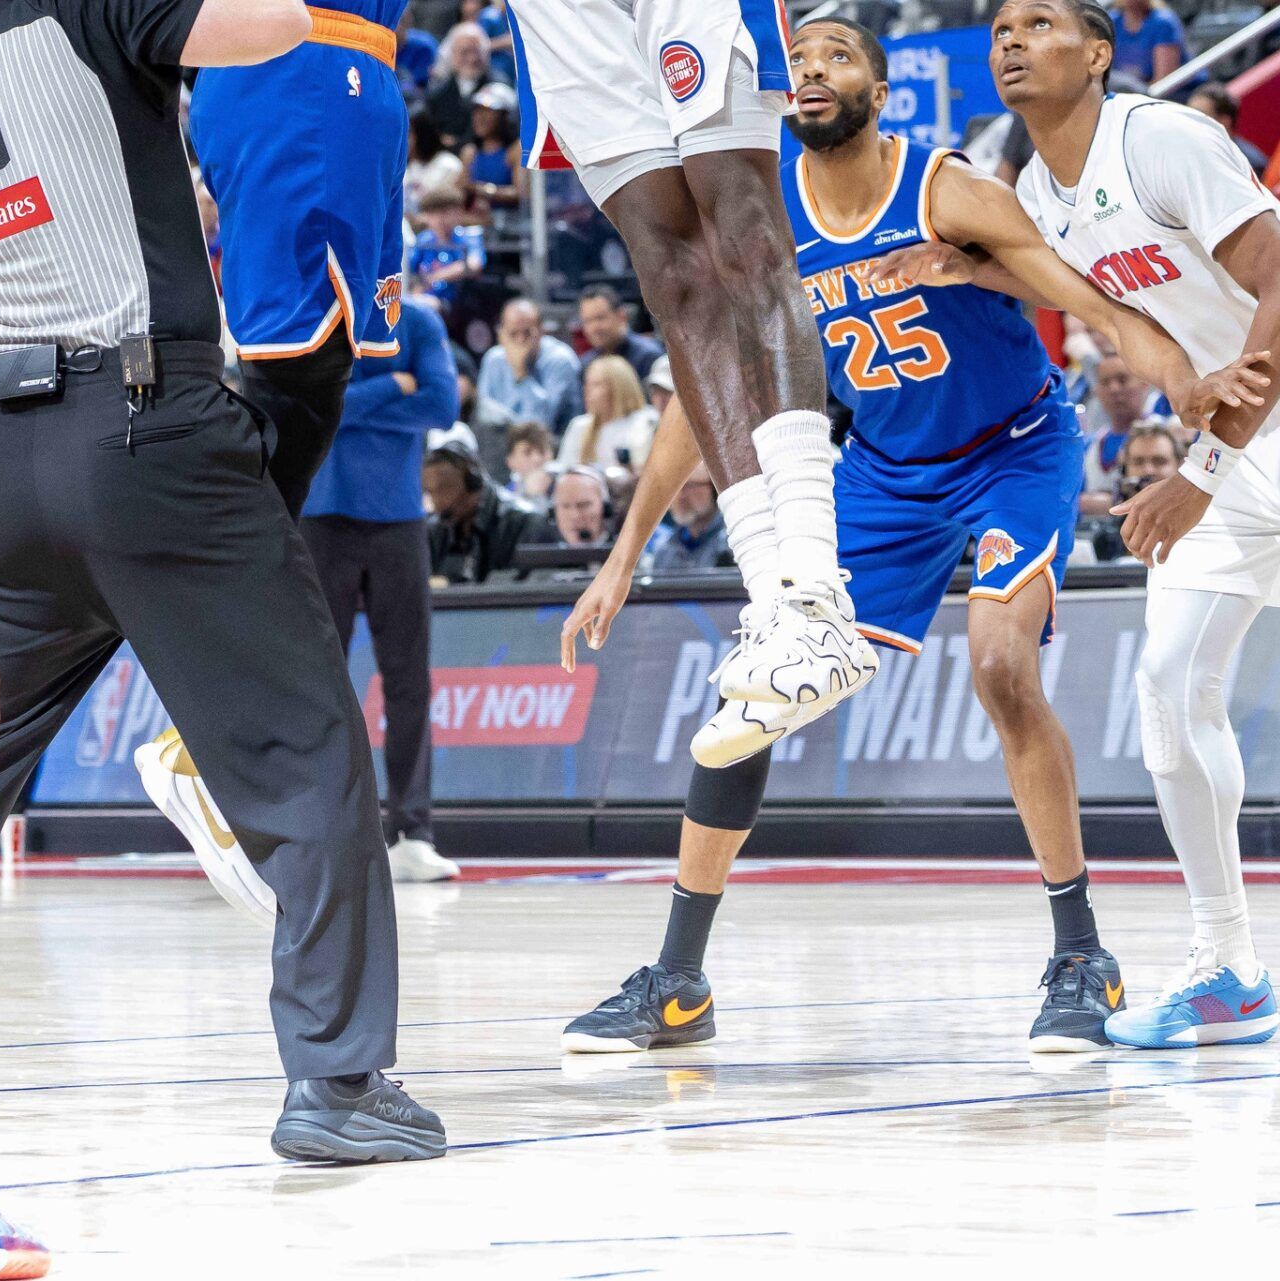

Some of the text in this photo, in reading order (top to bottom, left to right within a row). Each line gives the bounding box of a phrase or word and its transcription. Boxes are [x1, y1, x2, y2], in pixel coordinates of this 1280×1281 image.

[1094, 202, 1122, 221] StockX
[874, 227, 918, 246] abu dhabi
[801, 266, 848, 316] EW
[824, 294, 952, 391] 25
[478, 683, 576, 729] NOW
[373, 1097, 414, 1125] HOKA
